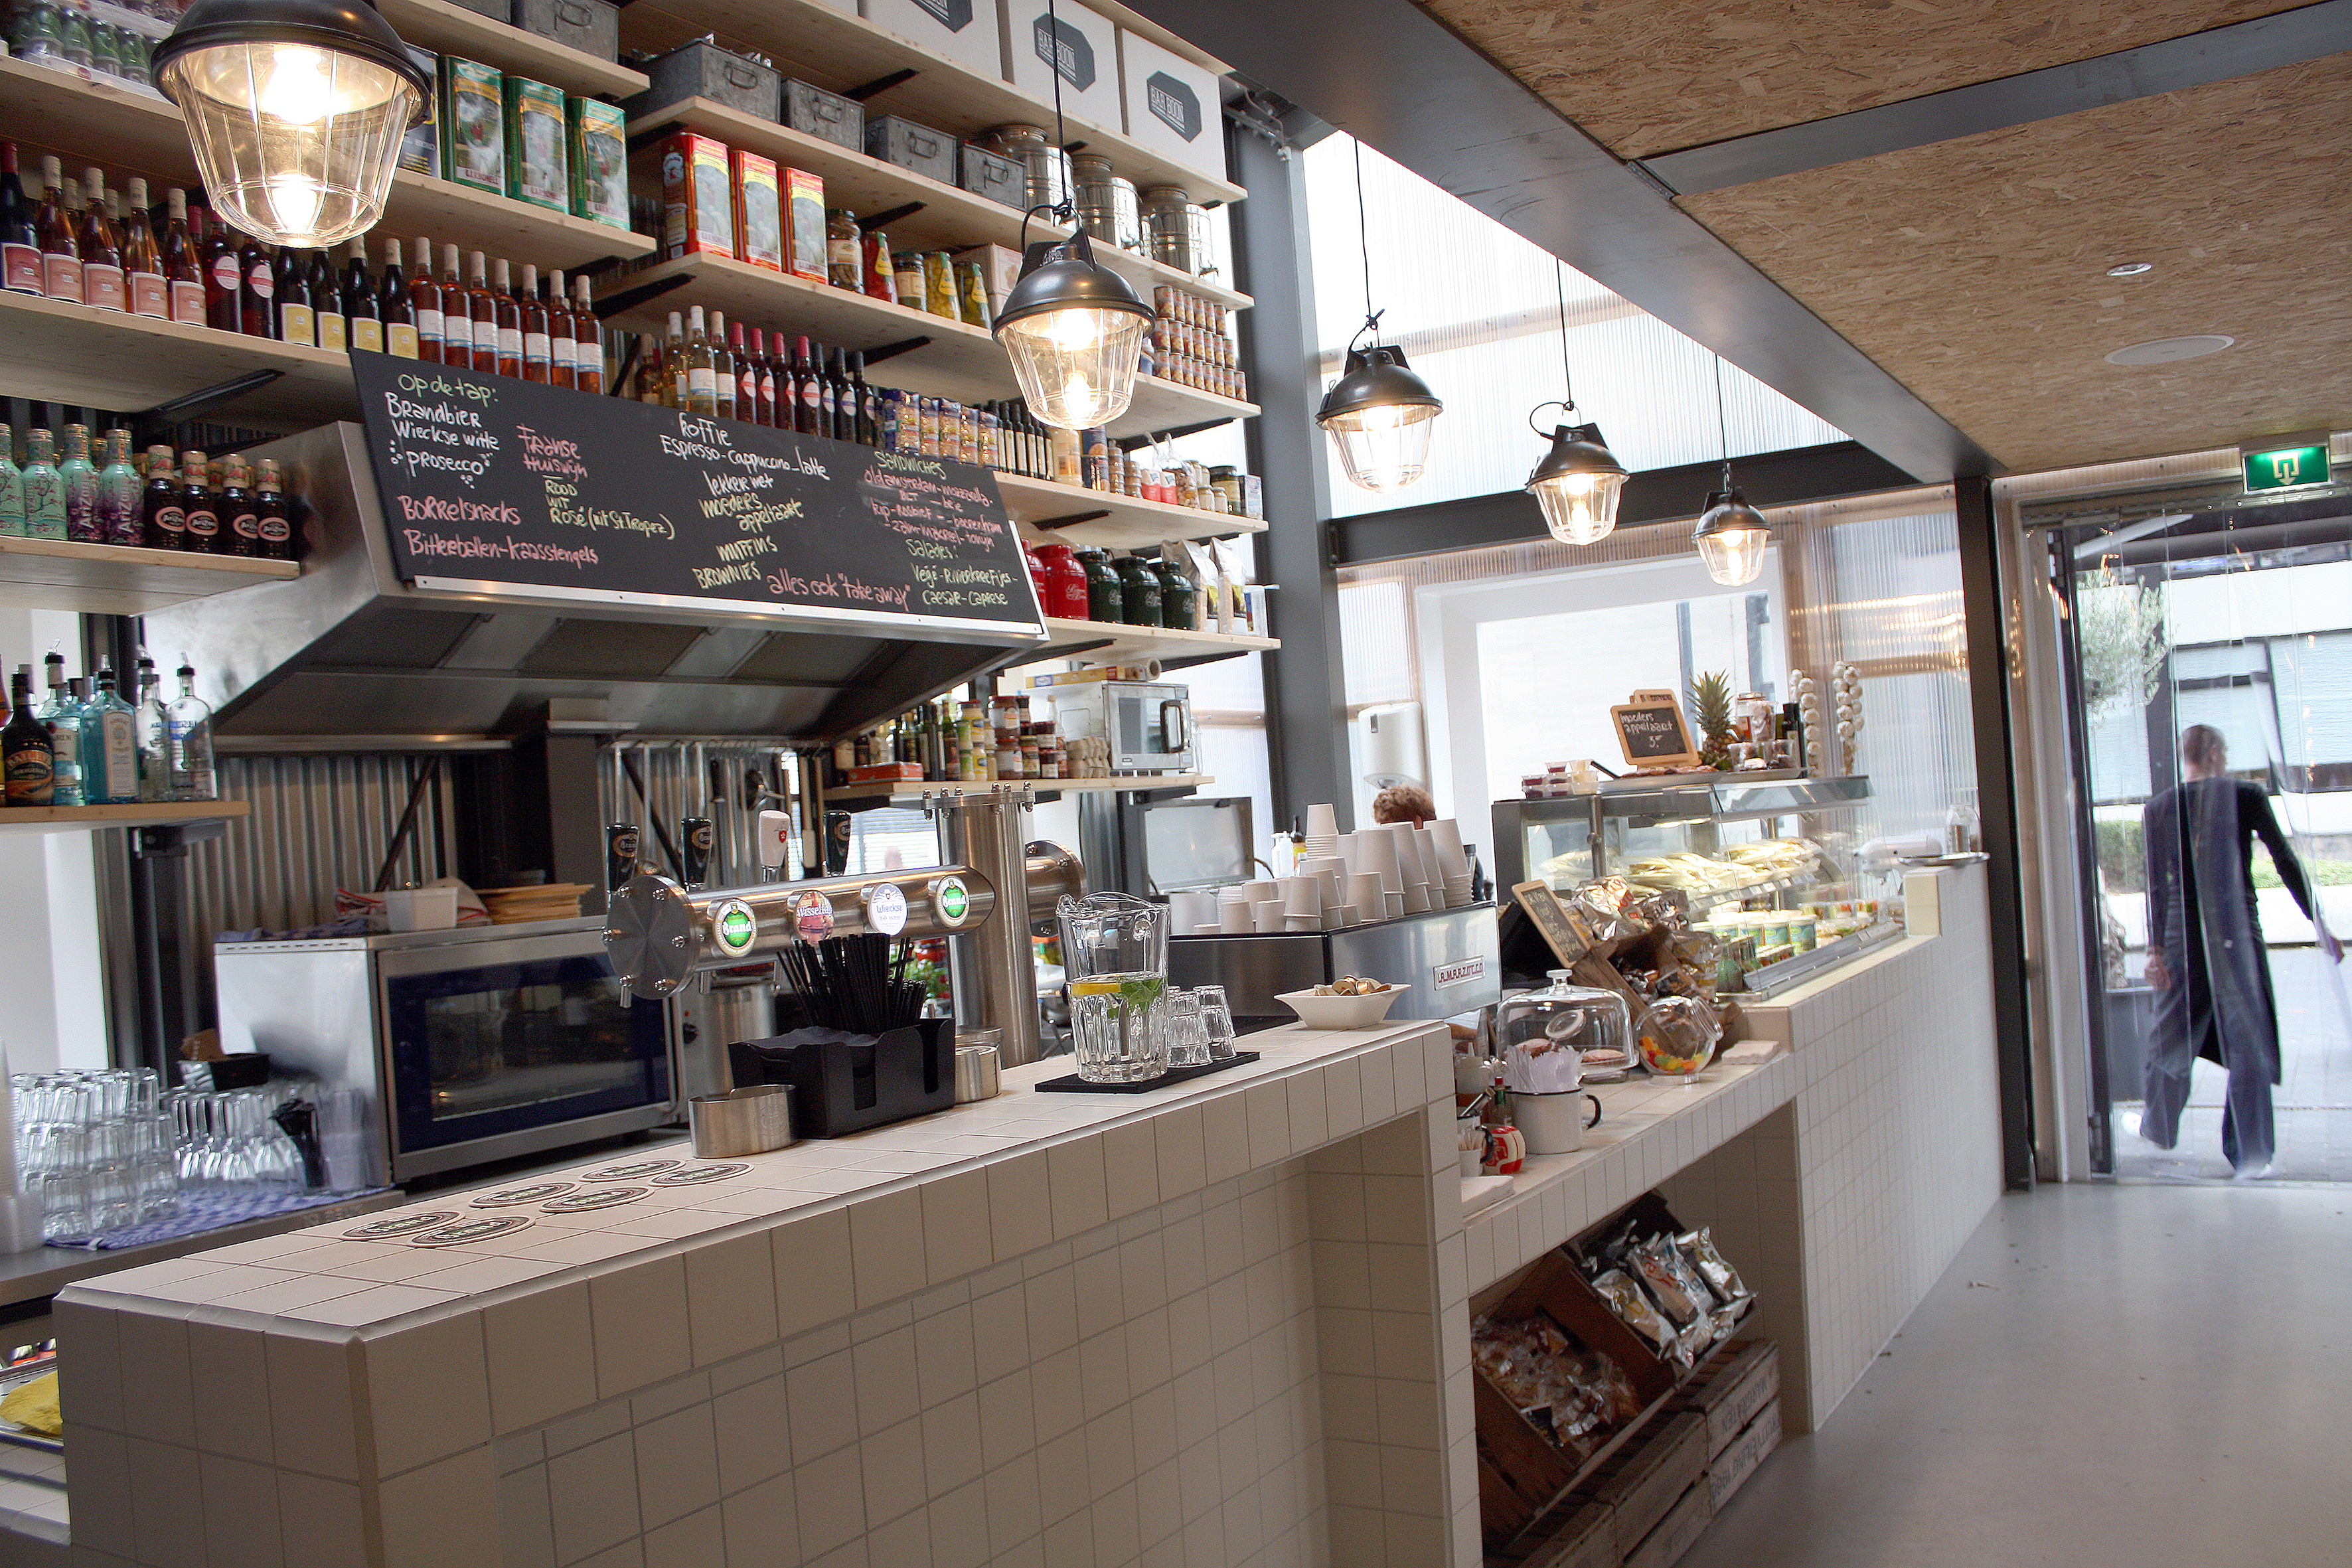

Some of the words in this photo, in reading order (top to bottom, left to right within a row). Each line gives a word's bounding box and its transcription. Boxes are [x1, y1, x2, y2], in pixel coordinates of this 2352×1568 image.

[1166, 96, 1185, 123] BOON
[430, 375, 454, 397] de
[392, 419, 461, 446] Wieckse
[765, 568, 809, 595] alles
[809, 574, 840, 597] ook
[876, 903, 903, 913] Wieckse
[943, 894, 967, 908] Brand
[722, 919, 753, 937] Brand
